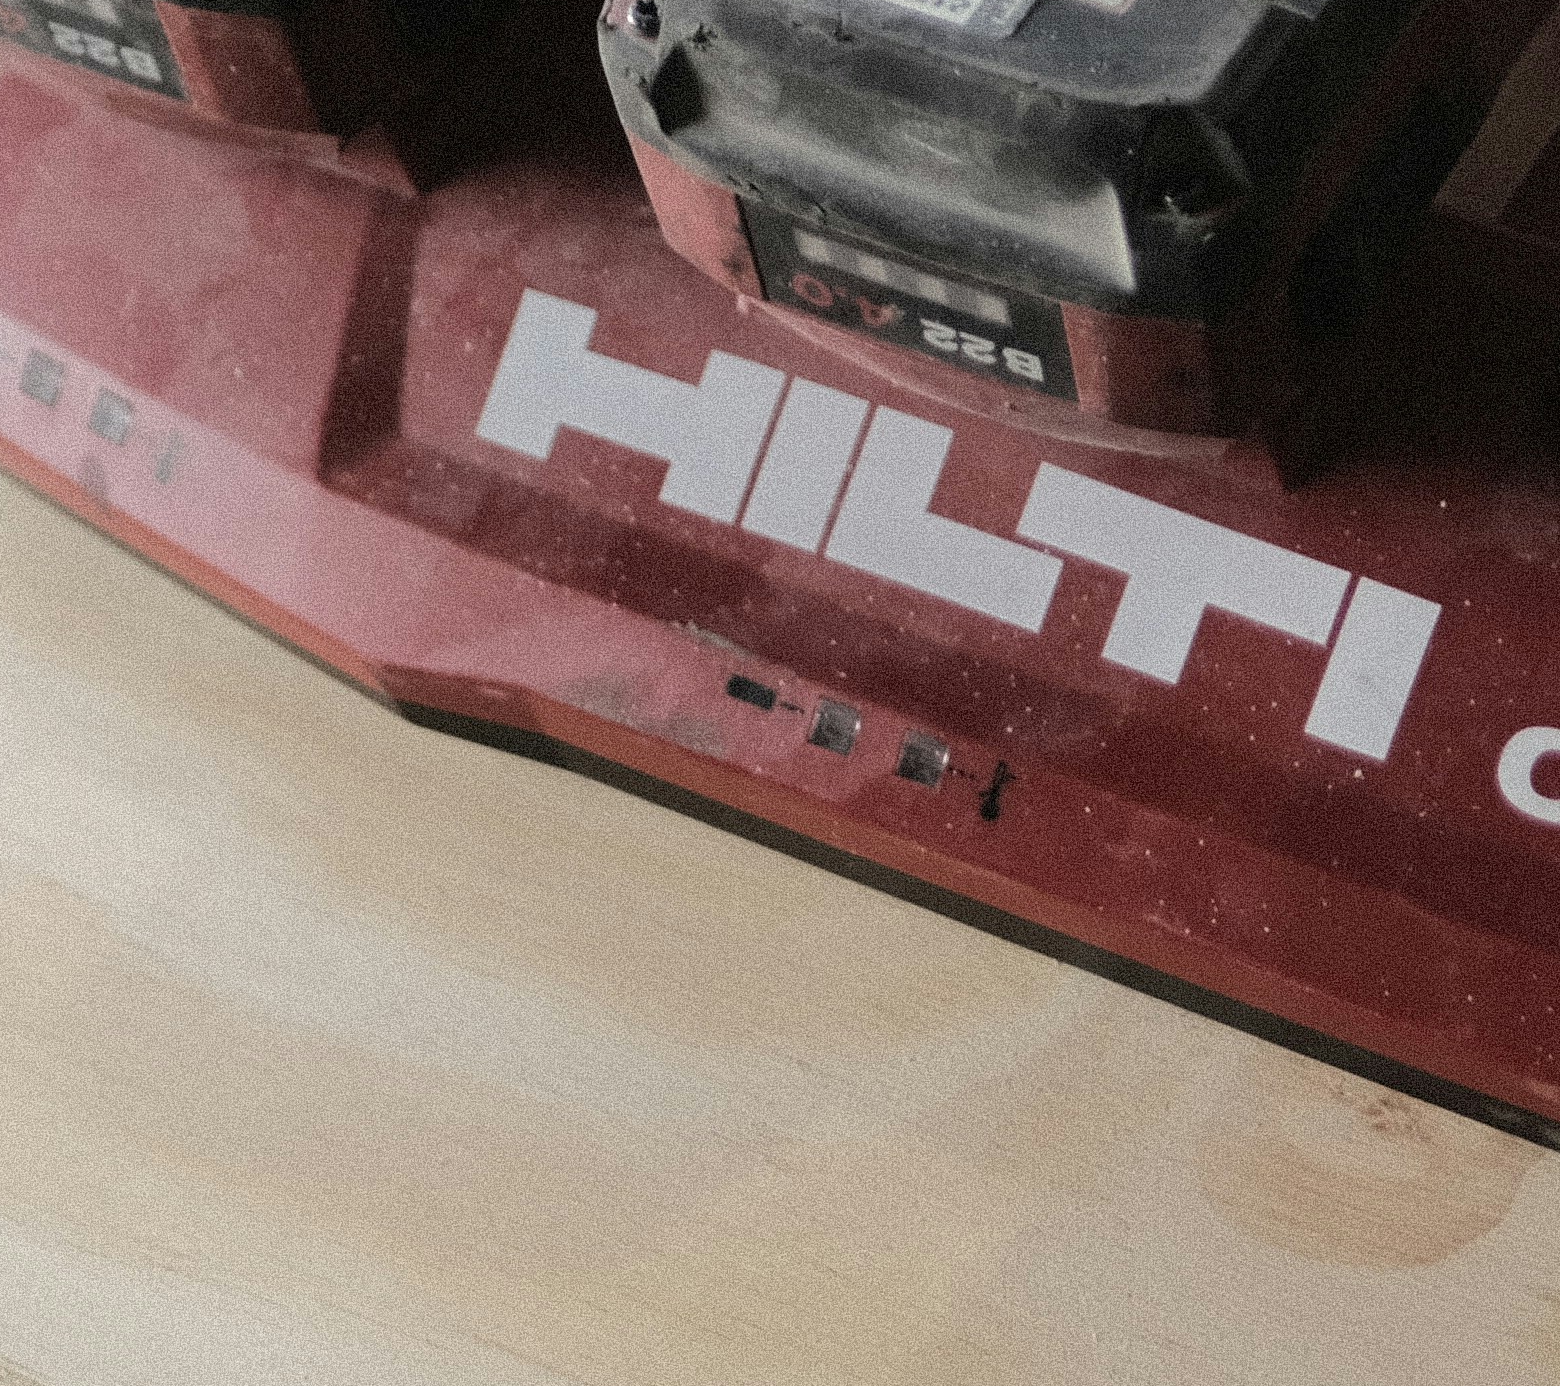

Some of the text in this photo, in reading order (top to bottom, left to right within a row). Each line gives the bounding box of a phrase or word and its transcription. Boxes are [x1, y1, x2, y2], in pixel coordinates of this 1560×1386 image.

[40, 20, 168, 83] B22
[913, 317, 1051, 382] B22
[476, 289, 1444, 762] HILTI
